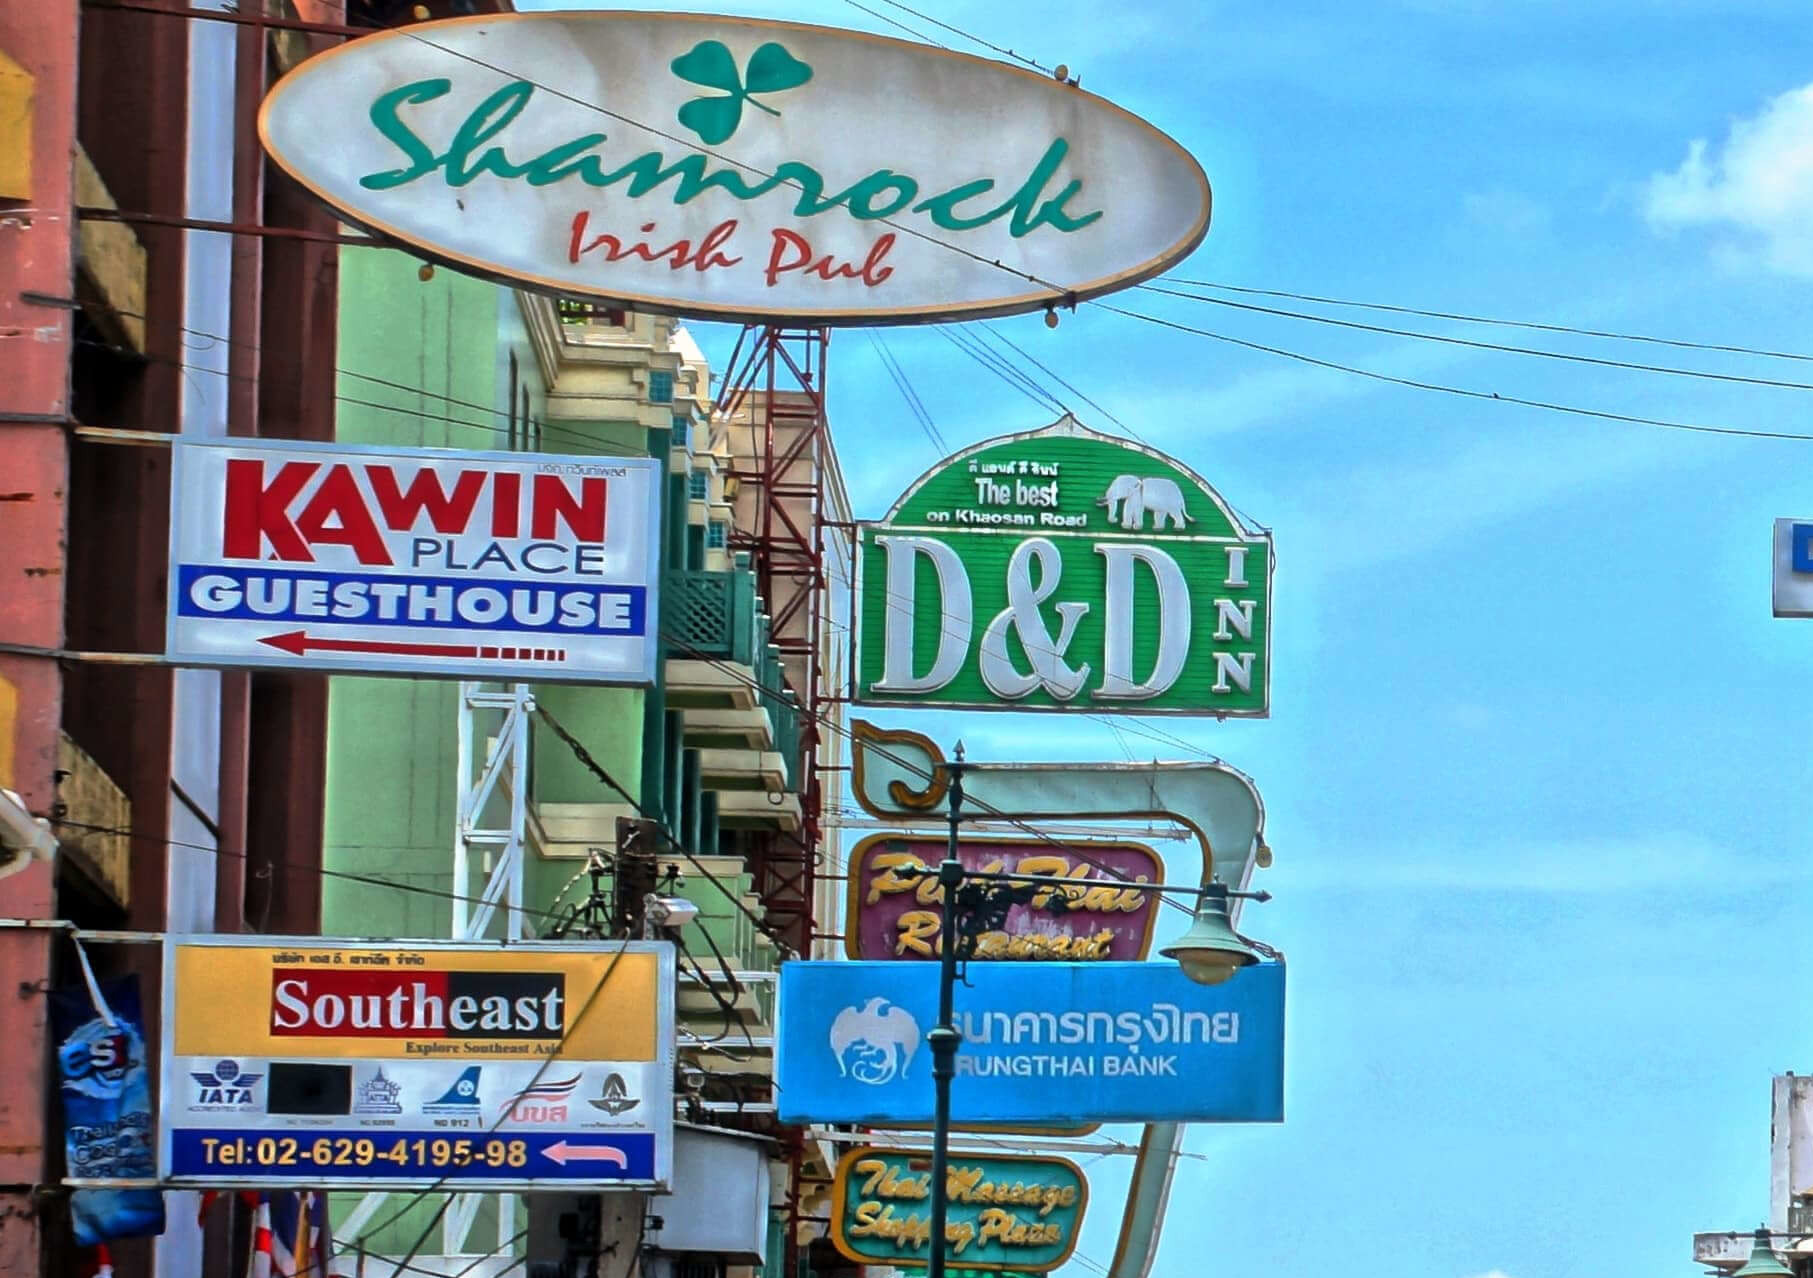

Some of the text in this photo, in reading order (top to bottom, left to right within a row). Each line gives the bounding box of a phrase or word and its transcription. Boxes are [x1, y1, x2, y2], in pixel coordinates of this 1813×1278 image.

[360, 78, 1105, 239] Shamrock
[565, 210, 897, 288] Irish Pub
[221, 458, 608, 567] KAWIN
[974, 478, 1059, 507] The best
[926, 509, 1088, 528] on Khaosan Road
[411, 537, 605, 576] PLACE
[190, 574, 632, 631] GUESTHOUSE
[869, 535, 1192, 701] D&D
[1211, 546, 1258, 694] INN
[273, 979, 564, 1033] Southeast
[405, 1041, 563, 1056] Explore Southeast Asia
[955, 1056, 1177, 1078] RUNGTHAI BANK
[199, 1087, 254, 1104] IATA
[201, 1137, 528, 1168] Tel:02-629-4195-98
[854, 1159, 1077, 1209] Thai Massage
[848, 1200, 975, 1253] Shoppng
